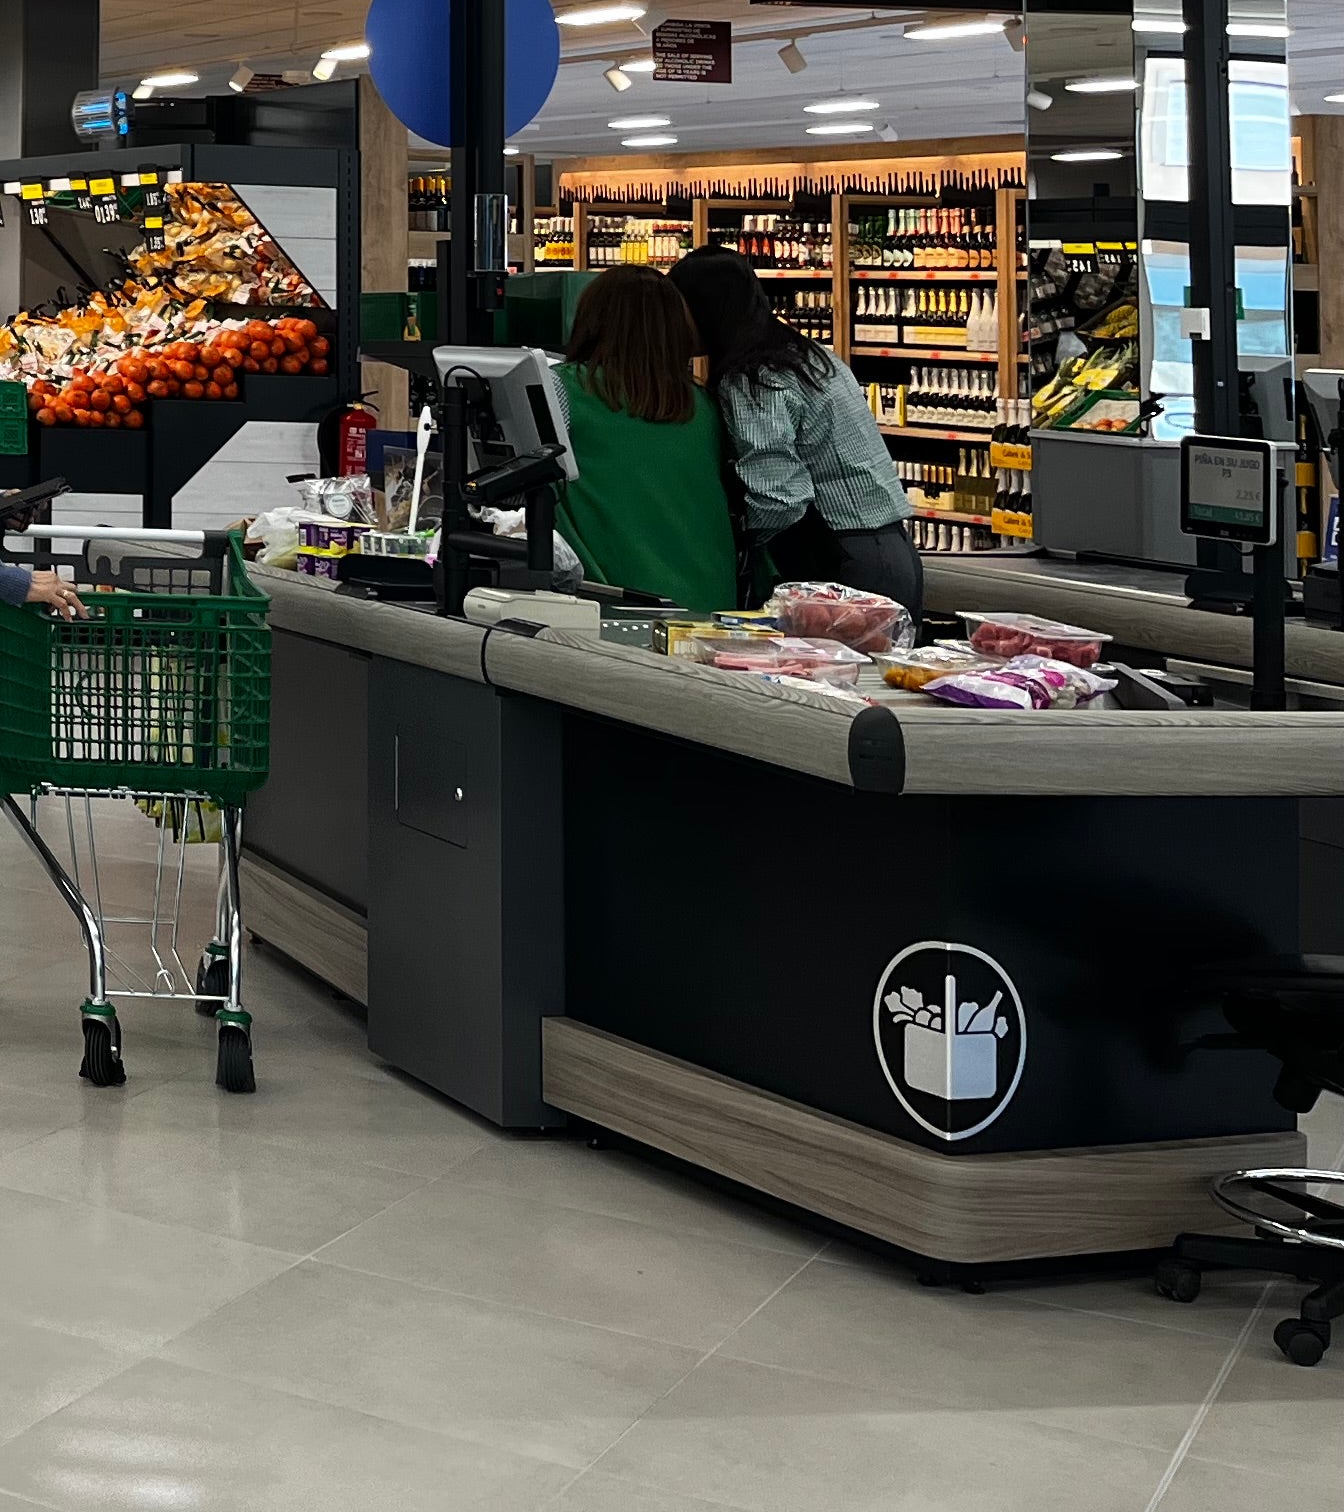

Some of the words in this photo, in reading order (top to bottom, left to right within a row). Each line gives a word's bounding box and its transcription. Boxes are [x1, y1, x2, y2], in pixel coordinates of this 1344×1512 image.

[1194, 452, 1213, 465] PIÑA
[1214, 455, 1225, 466] EN
[1225, 457, 1237, 467] SU
